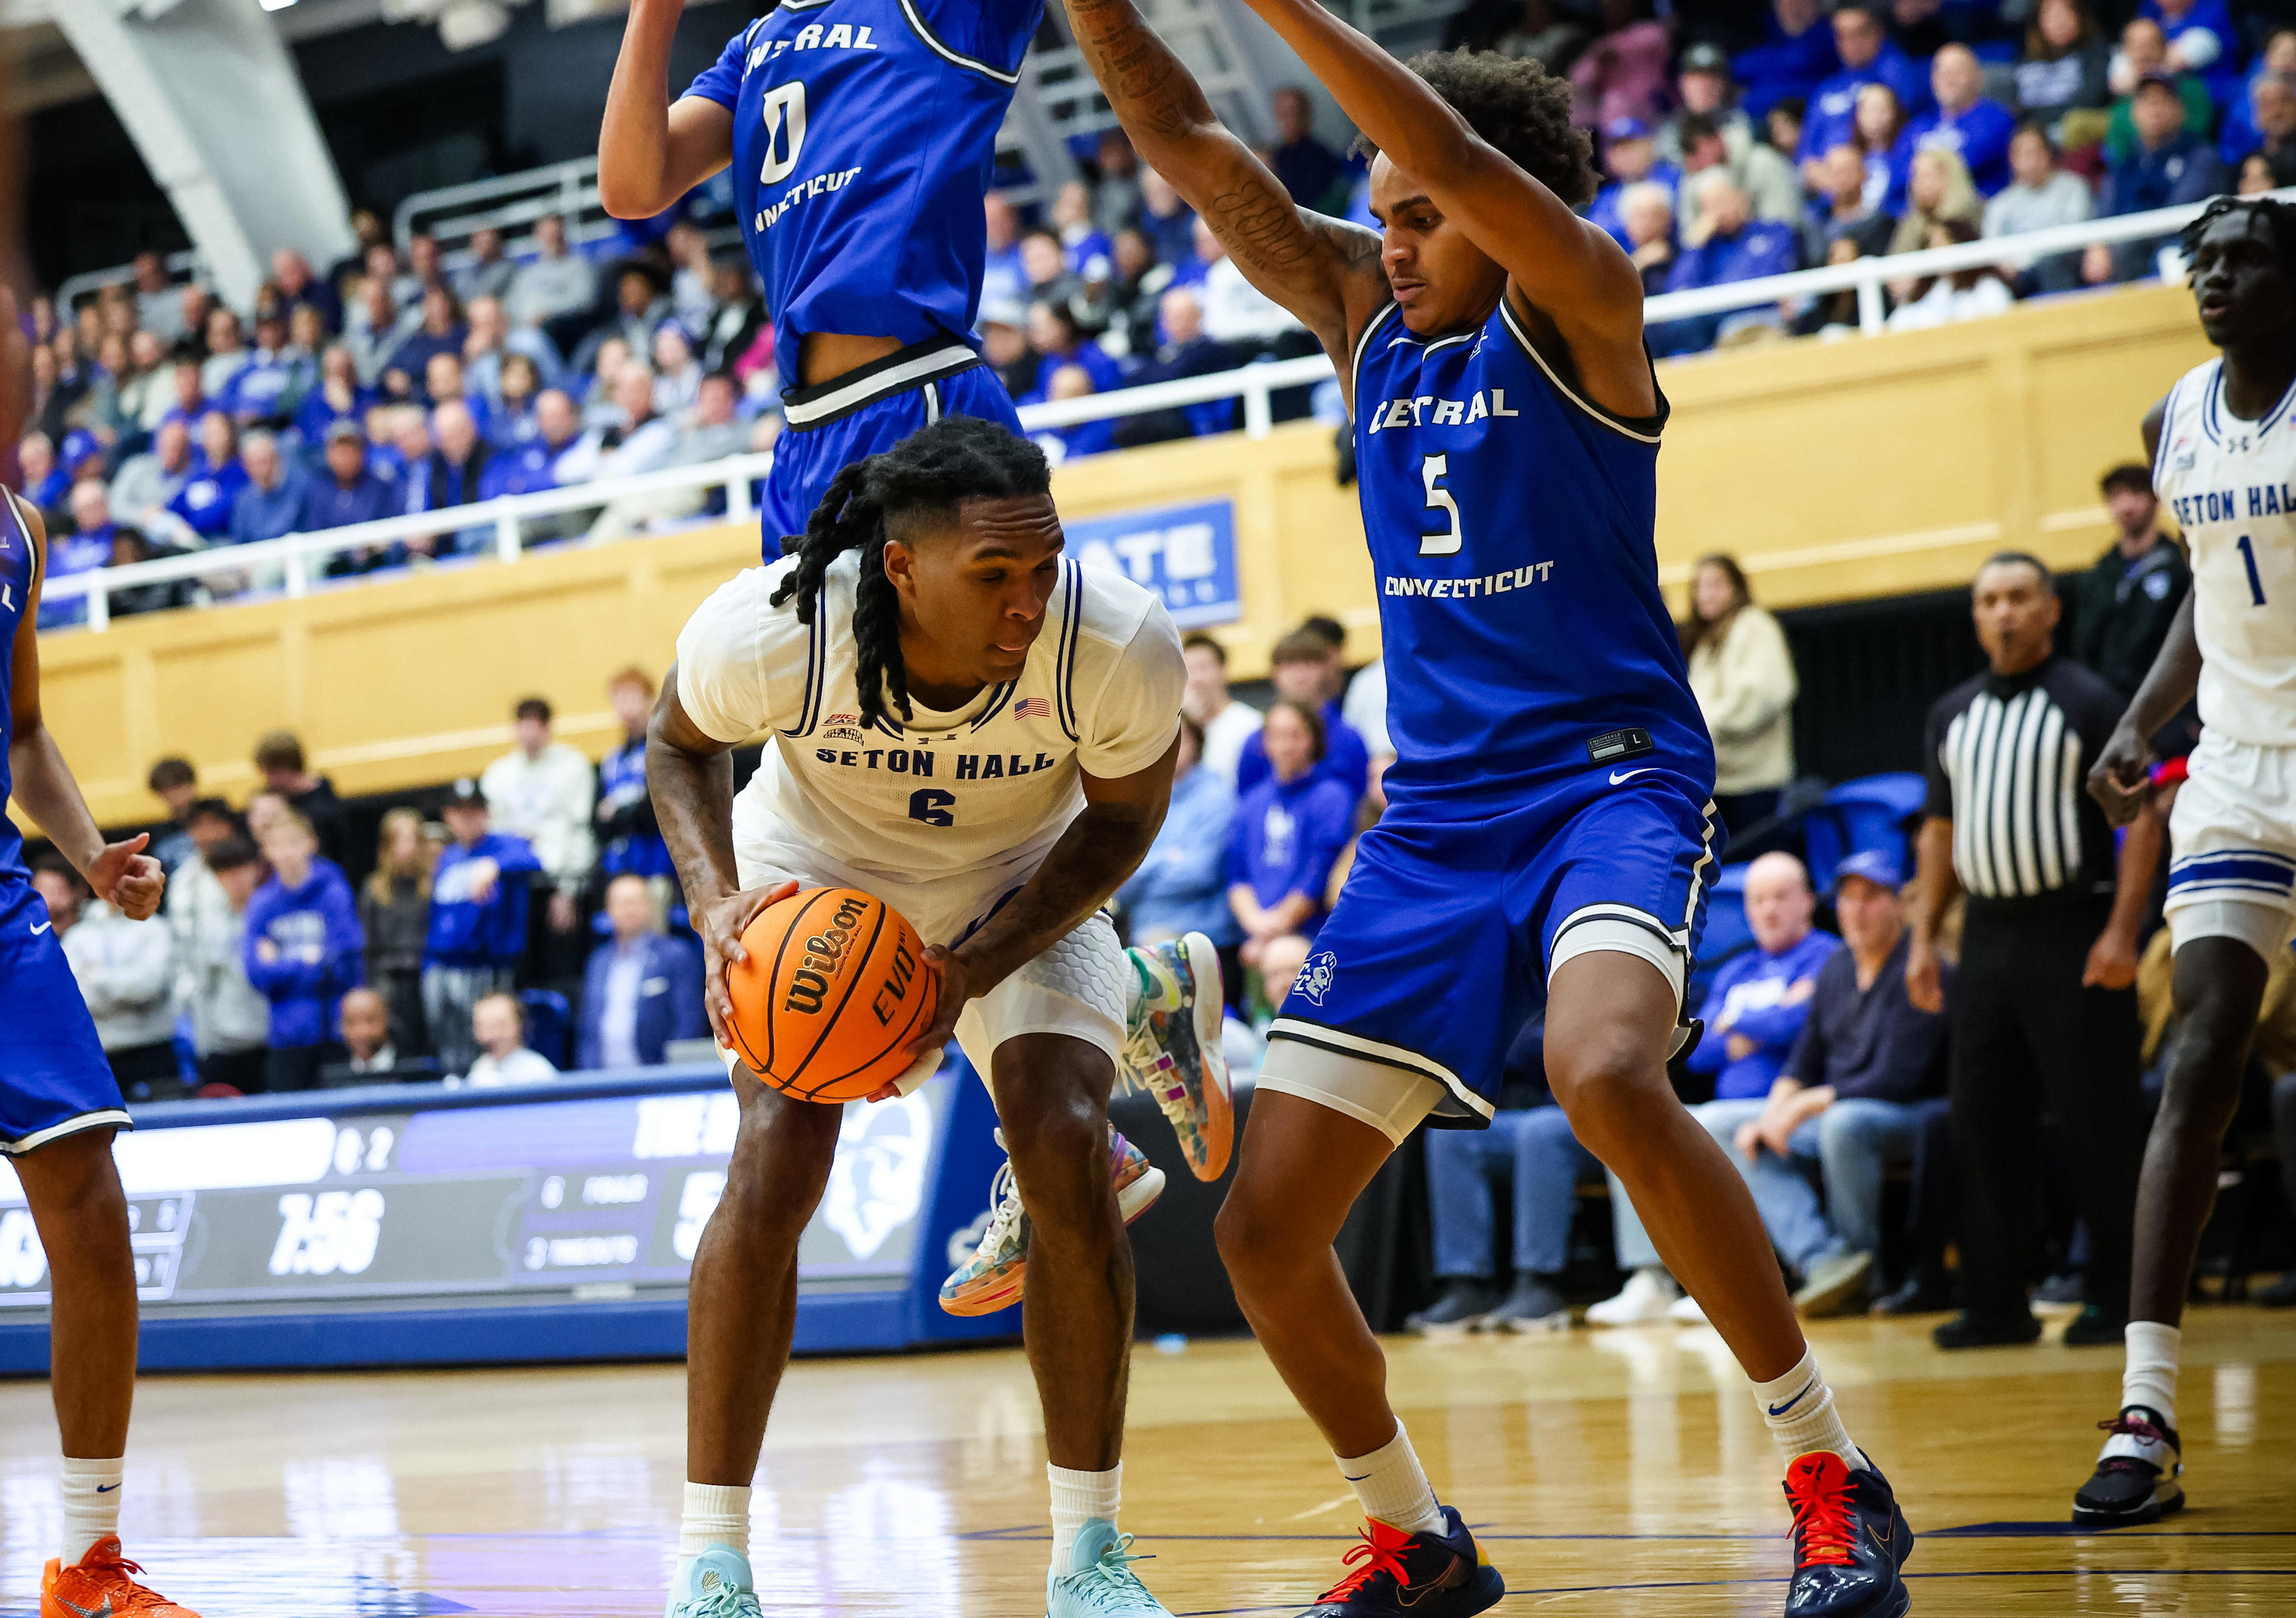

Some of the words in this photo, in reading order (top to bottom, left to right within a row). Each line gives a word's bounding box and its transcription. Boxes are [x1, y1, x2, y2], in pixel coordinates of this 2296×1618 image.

[760, 80, 808, 186] 0
[1369, 389, 1519, 434] CETRAL
[1418, 452, 1463, 557] 5
[1384, 560, 1554, 599] CONNECTICUT
[2237, 535, 2267, 607] 1
[823, 733, 864, 746] CHANGE
[844, 728, 862, 740] THE
[1632, 734, 1641, 744] L
[816, 748, 934, 777] SETON
[956, 752, 1055, 780] HALL
[908, 788, 956, 827] 6
[783, 897, 869, 1015] Wilson
[835, 955, 848, 981] INDOOR
[846, 938, 856, 955] GAME
[854, 924, 864, 938] BALL
[871, 944, 916, 1027] EVO
